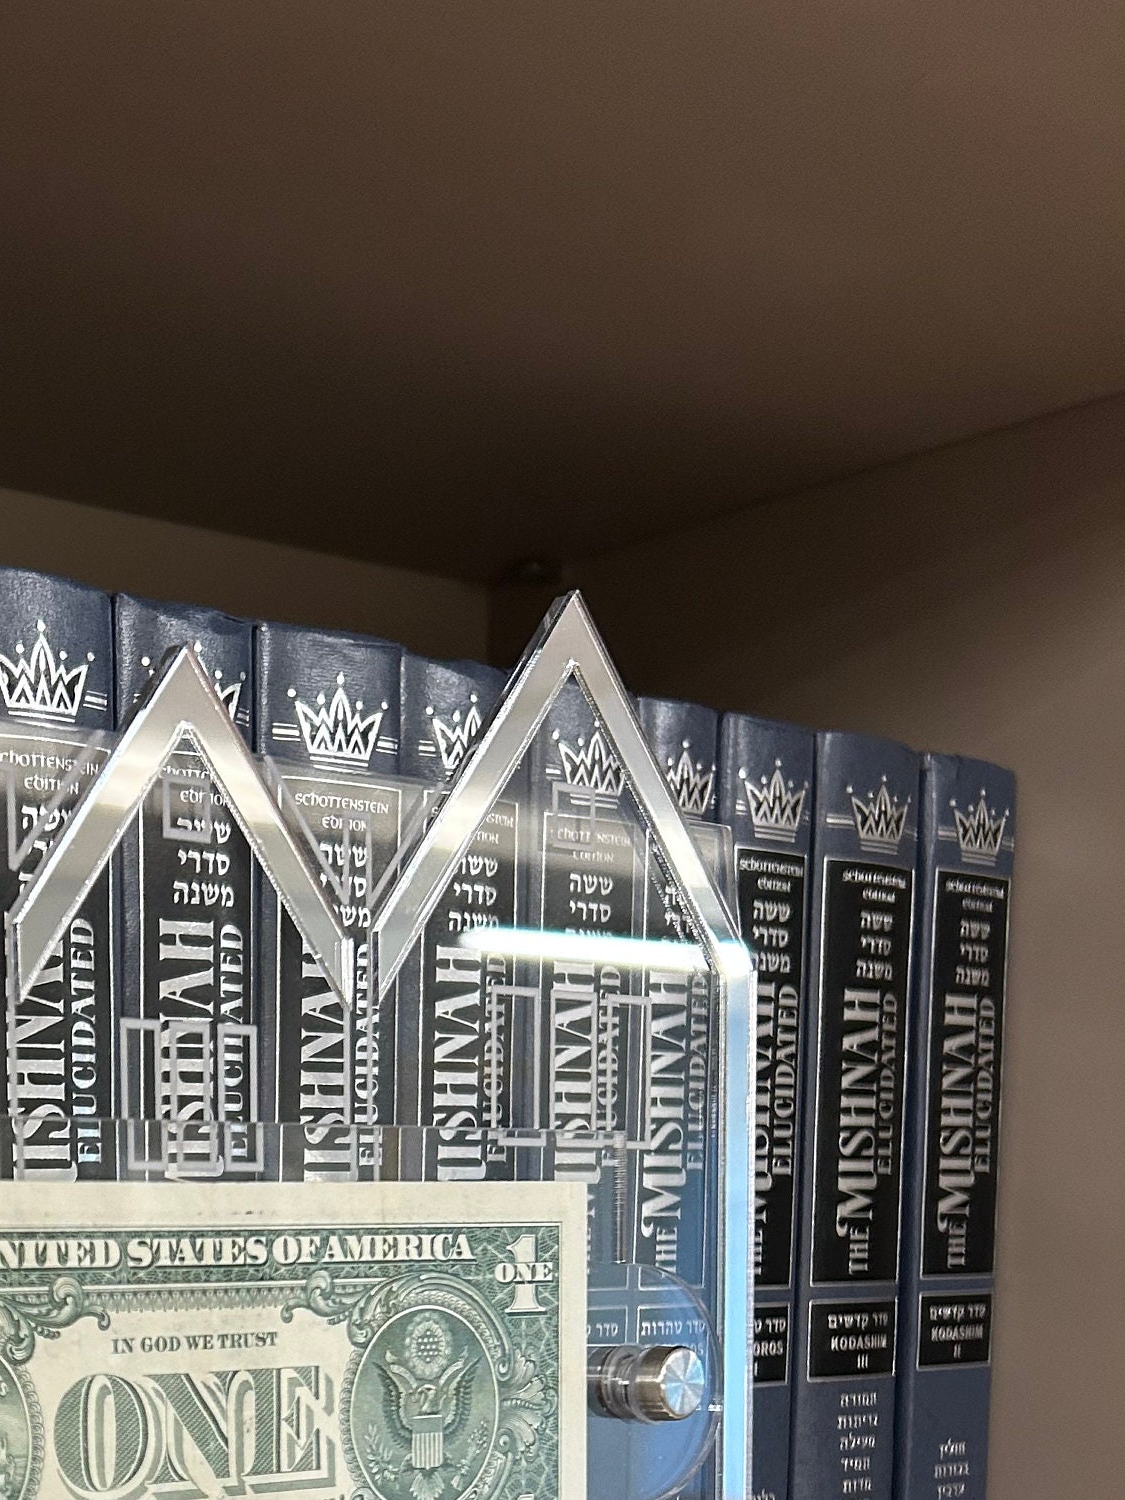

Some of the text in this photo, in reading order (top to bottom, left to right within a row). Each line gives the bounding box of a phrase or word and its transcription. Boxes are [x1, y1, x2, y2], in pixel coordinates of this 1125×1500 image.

[177, 849, 231, 877] סדרי
[173, 879, 235, 908] משנה
[452, 881, 498, 906] סדרי
[568, 872, 614, 896] ששה
[568, 899, 612, 924] סדרי
[752, 899, 791, 922] ששה
[859, 909, 894, 932] ששה
[751, 927, 789, 949] סדרי
[772, 983, 799, 1176] ELUCIDATED
[877, 992, 898, 1177] ELUCIDATED
[974, 998, 996, 1174] ELUCIDATED
[835, 987, 882, 1276] THE MISHNAH
[937, 992, 980, 1270] THE MISHNAH
[127, 1234, 269, 1268] STATES
[272, 1235, 323, 1268] OF
[322, 1233, 477, 1266] AMERICA
[493, 1262, 554, 1285] ONE
[112, 1332, 279, 1355] IN GOD WE TRUST
[856, 1353, 869, 1370] III
